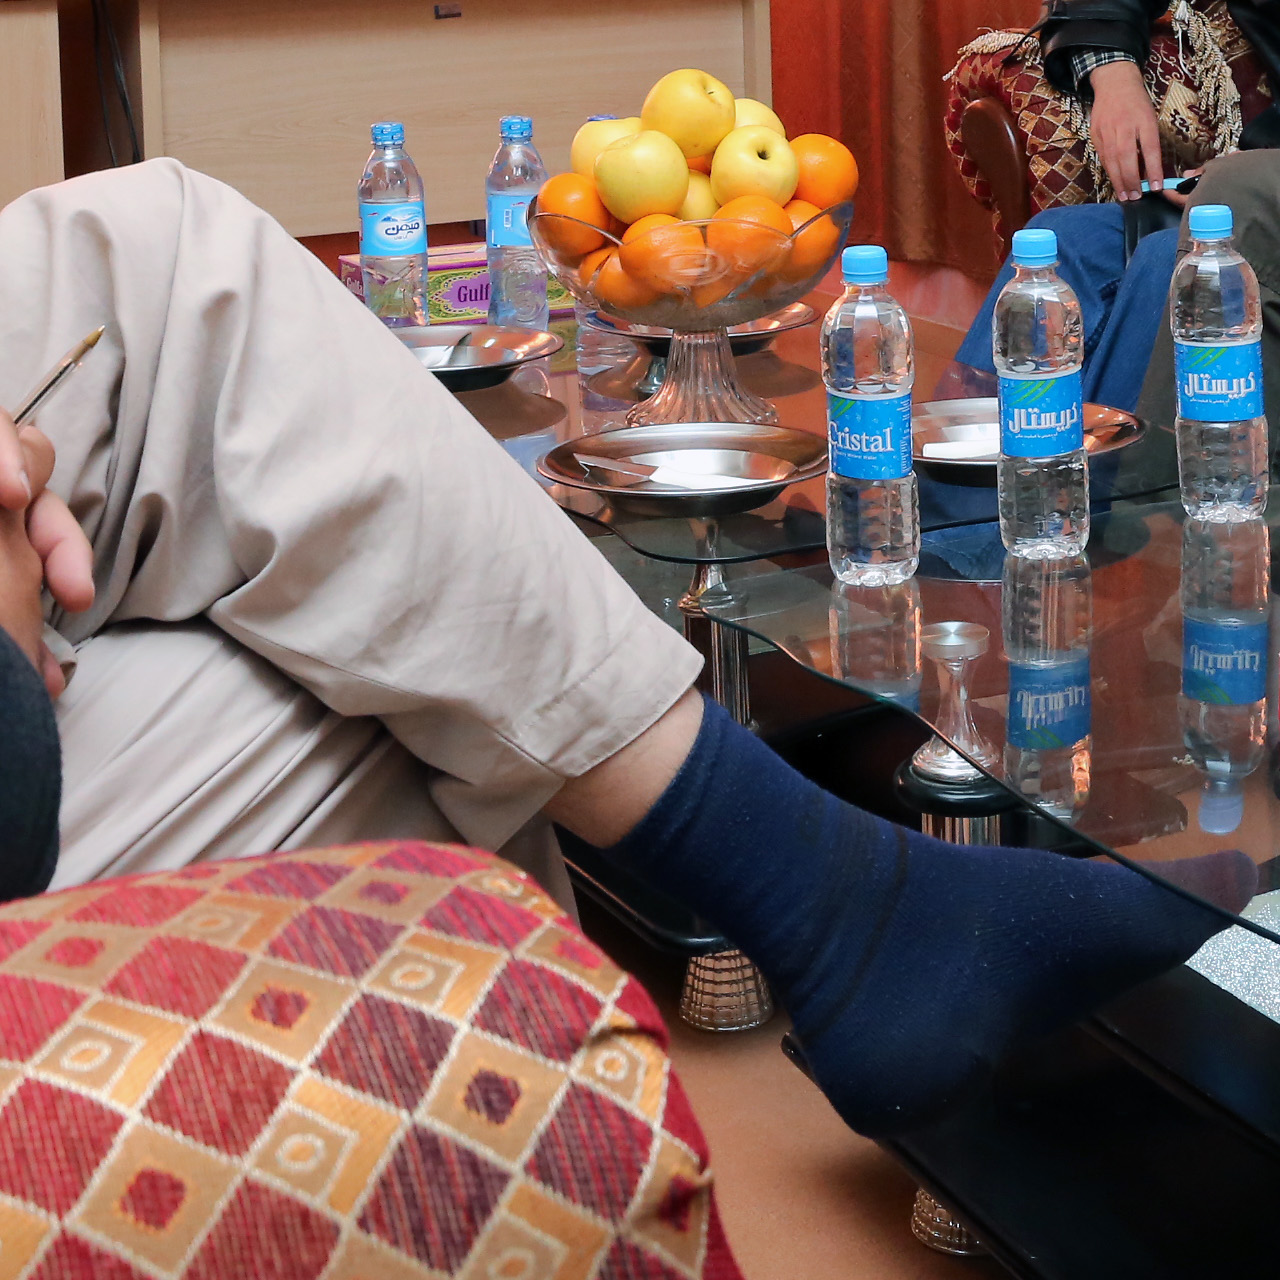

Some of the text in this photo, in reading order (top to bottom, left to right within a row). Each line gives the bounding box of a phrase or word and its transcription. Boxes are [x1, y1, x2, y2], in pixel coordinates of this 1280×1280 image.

[1183, 371, 1256, 399] کریستال
[1008, 401, 1078, 433] کریستال
[828, 421, 895, 453] Cristal
